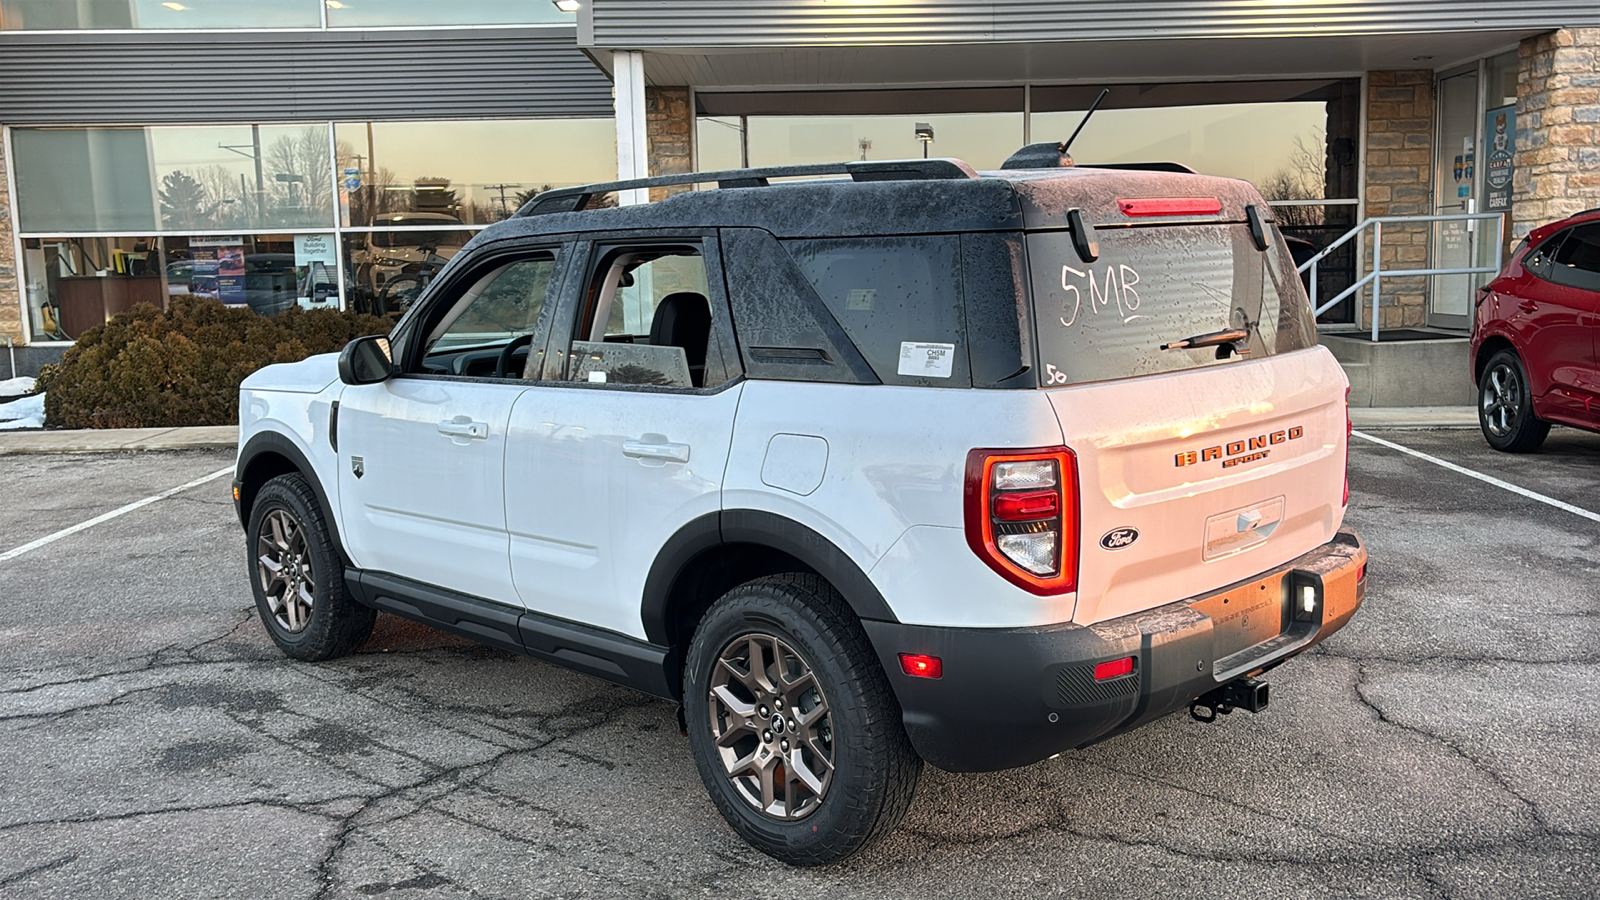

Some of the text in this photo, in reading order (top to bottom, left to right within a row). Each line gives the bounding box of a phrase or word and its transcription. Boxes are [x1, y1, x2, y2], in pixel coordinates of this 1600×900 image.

[1489, 197, 1507, 208] CARFAX
[1174, 425, 1304, 467] BRONCO
[1222, 449, 1270, 468] SPORT
[1108, 530, 1134, 547] Ford
